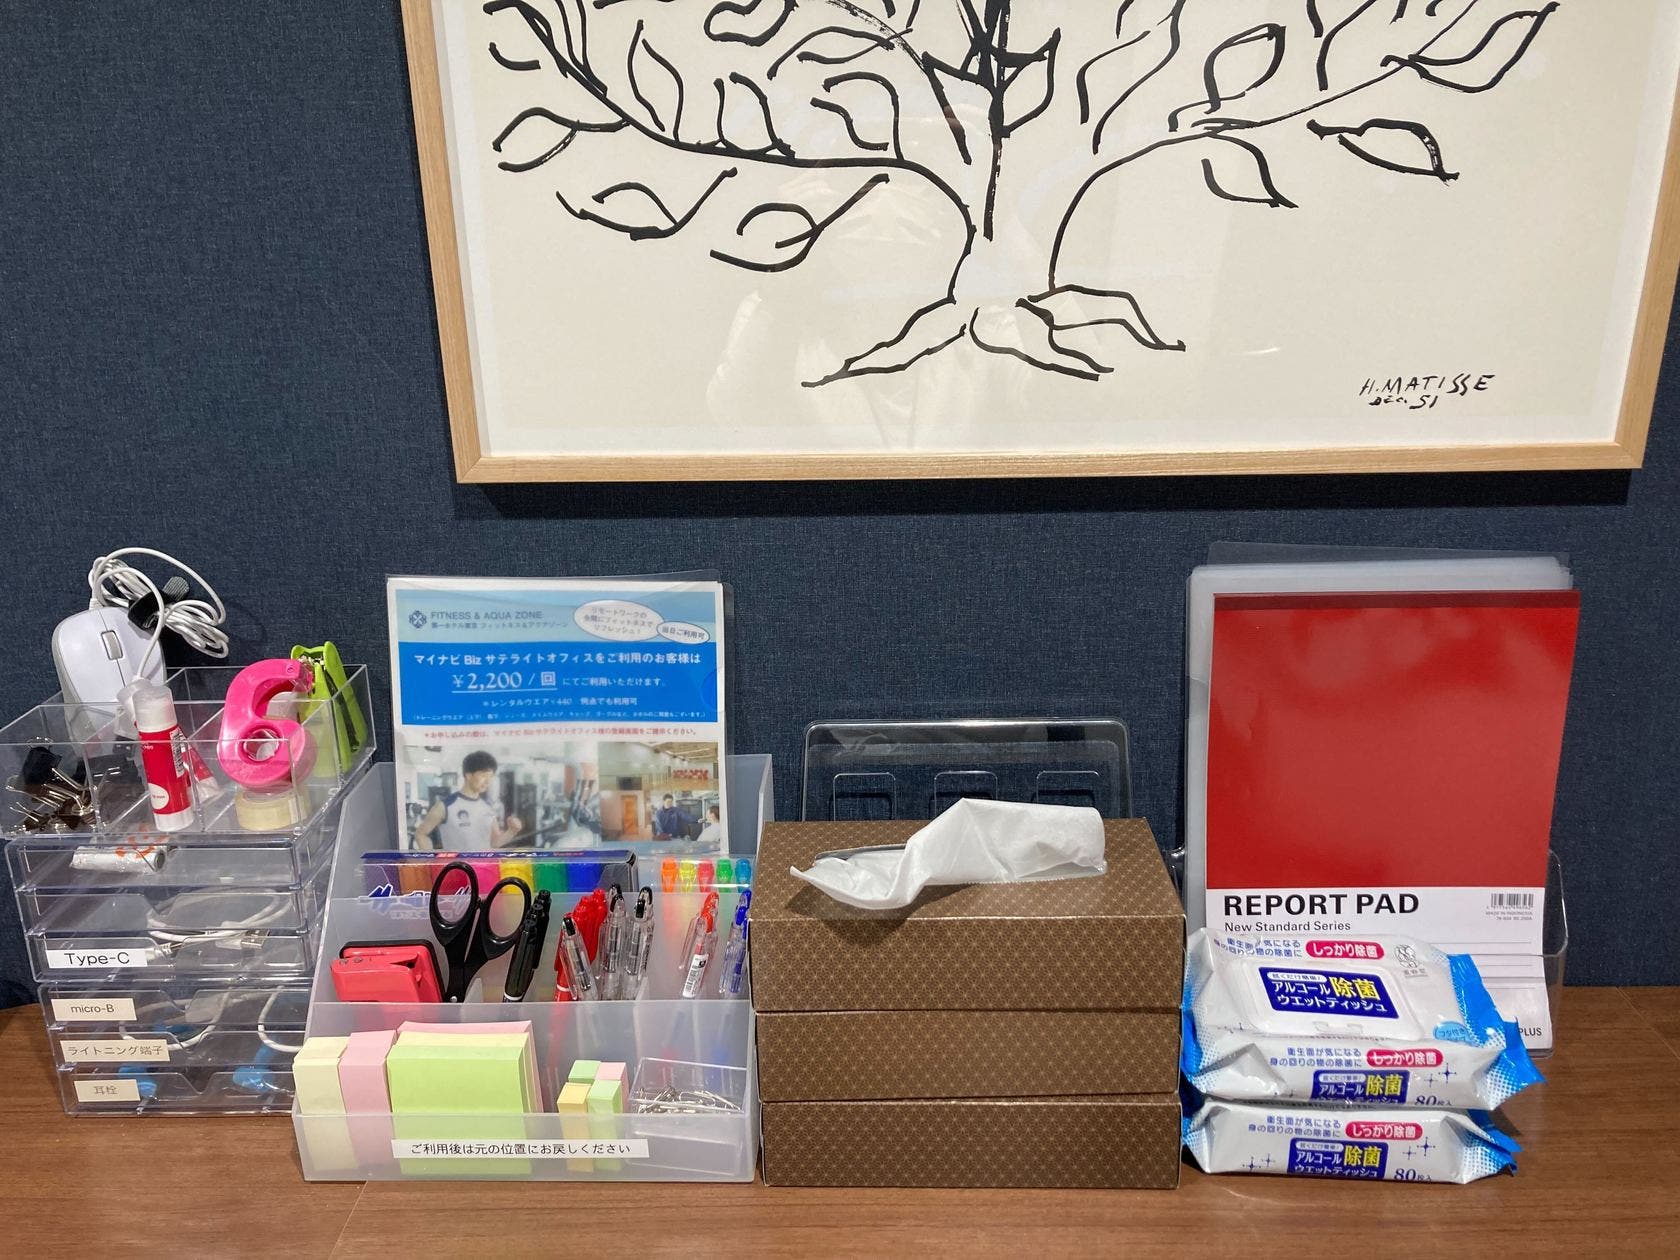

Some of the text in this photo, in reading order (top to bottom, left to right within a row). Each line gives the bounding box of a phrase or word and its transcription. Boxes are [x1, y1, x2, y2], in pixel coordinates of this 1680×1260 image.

[1409, 394, 1438, 409] 51
[430, 611, 471, 620] FITNESS
[483, 611, 512, 621] AQUA
[515, 610, 543, 620] ZONE
[414, 651, 702, 666] マイナビ Biz サテライトオフィスをご利用のお客様は
[452, 671, 523, 691] ¥2,200
[1224, 893, 1420, 916] REPORT PAD
[1225, 920, 1351, 932] New Standard Series
[1313, 943, 1378, 959] しっかり除菌
[64, 952, 131, 966] Type-C
[71, 1003, 115, 1013] micro-B
[1277, 995, 1388, 1012] ウエットティッシュ
[68, 1046, 163, 1056] ライトニング端子
[1287, 1047, 1361, 1057] 衛生面が気になる
[1270, 1058, 1362, 1068] 身の回りの物の除菌に
[1372, 1052, 1437, 1066] しっかり除菌
[94, 1085, 118, 1095] 耳栓
[1267, 1115, 1341, 1129] 衛生面が気になる
[1248, 1124, 1341, 1138] 身の回りの物の除菌に
[1352, 1124, 1416, 1139] しっかり除菌
[411, 1143, 631, 1156] ご利用後は元の位置にお戻しください
